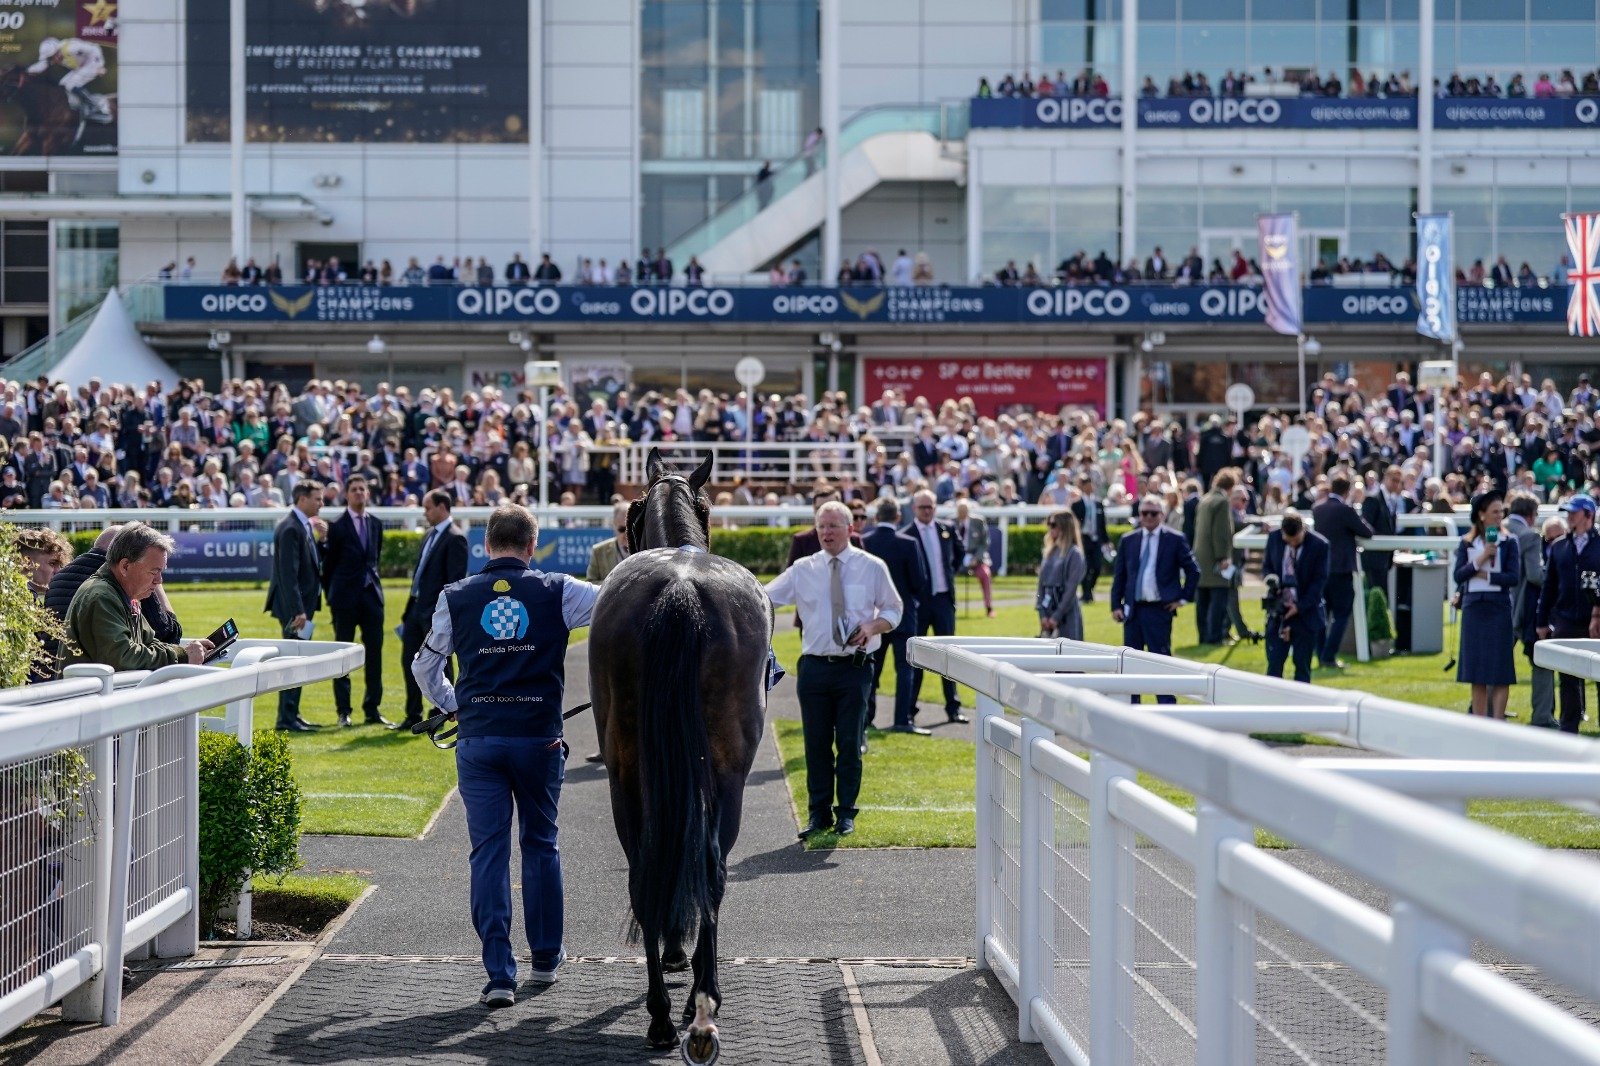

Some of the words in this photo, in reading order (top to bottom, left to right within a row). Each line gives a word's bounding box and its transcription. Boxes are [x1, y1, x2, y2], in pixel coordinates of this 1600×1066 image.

[396, 45, 482, 58] CHAMPIONS
[297, 57, 356, 69] BRITISH
[361, 57, 393, 69] FLAT
[399, 57, 452, 69] RACING
[1036, 98, 1123, 123] QIPCO
[1144, 110, 1181, 123] QIPCO
[1188, 98, 1280, 123] QIPCO
[1310, 106, 1411, 121] qipco.com.qa
[1446, 106, 1546, 121] qipco.com.qa
[317, 288, 381, 297] BRITISH
[887, 288, 951, 298] BRITISH
[1458, 287, 1521, 298] BRITISH
[201, 294, 267, 312] QIPCO
[317, 297, 414, 311] CHAMPIONS
[457, 289, 561, 316] QIPCO
[580, 302, 621, 315] QIPCO
[630, 289, 734, 316] QIPCO
[773, 295, 839, 314] QIPCO
[887, 298, 984, 312] CHAMPIONS
[1026, 289, 1131, 316] QIPCO
[1149, 302, 1190, 316] QIPCO
[1200, 289, 1268, 316] QIPC
[1342, 295, 1408, 315] QIPCO
[1457, 298, 1553, 312] CHAMPIONS
[317, 311, 375, 320] SERIES
[888, 311, 945, 321] SERIES
[1458, 311, 1514, 321] SERIES
[203, 542, 251, 557] CLUB
[507, 644, 536, 652] Picotte
[471, 696, 495, 704] QIPCO
